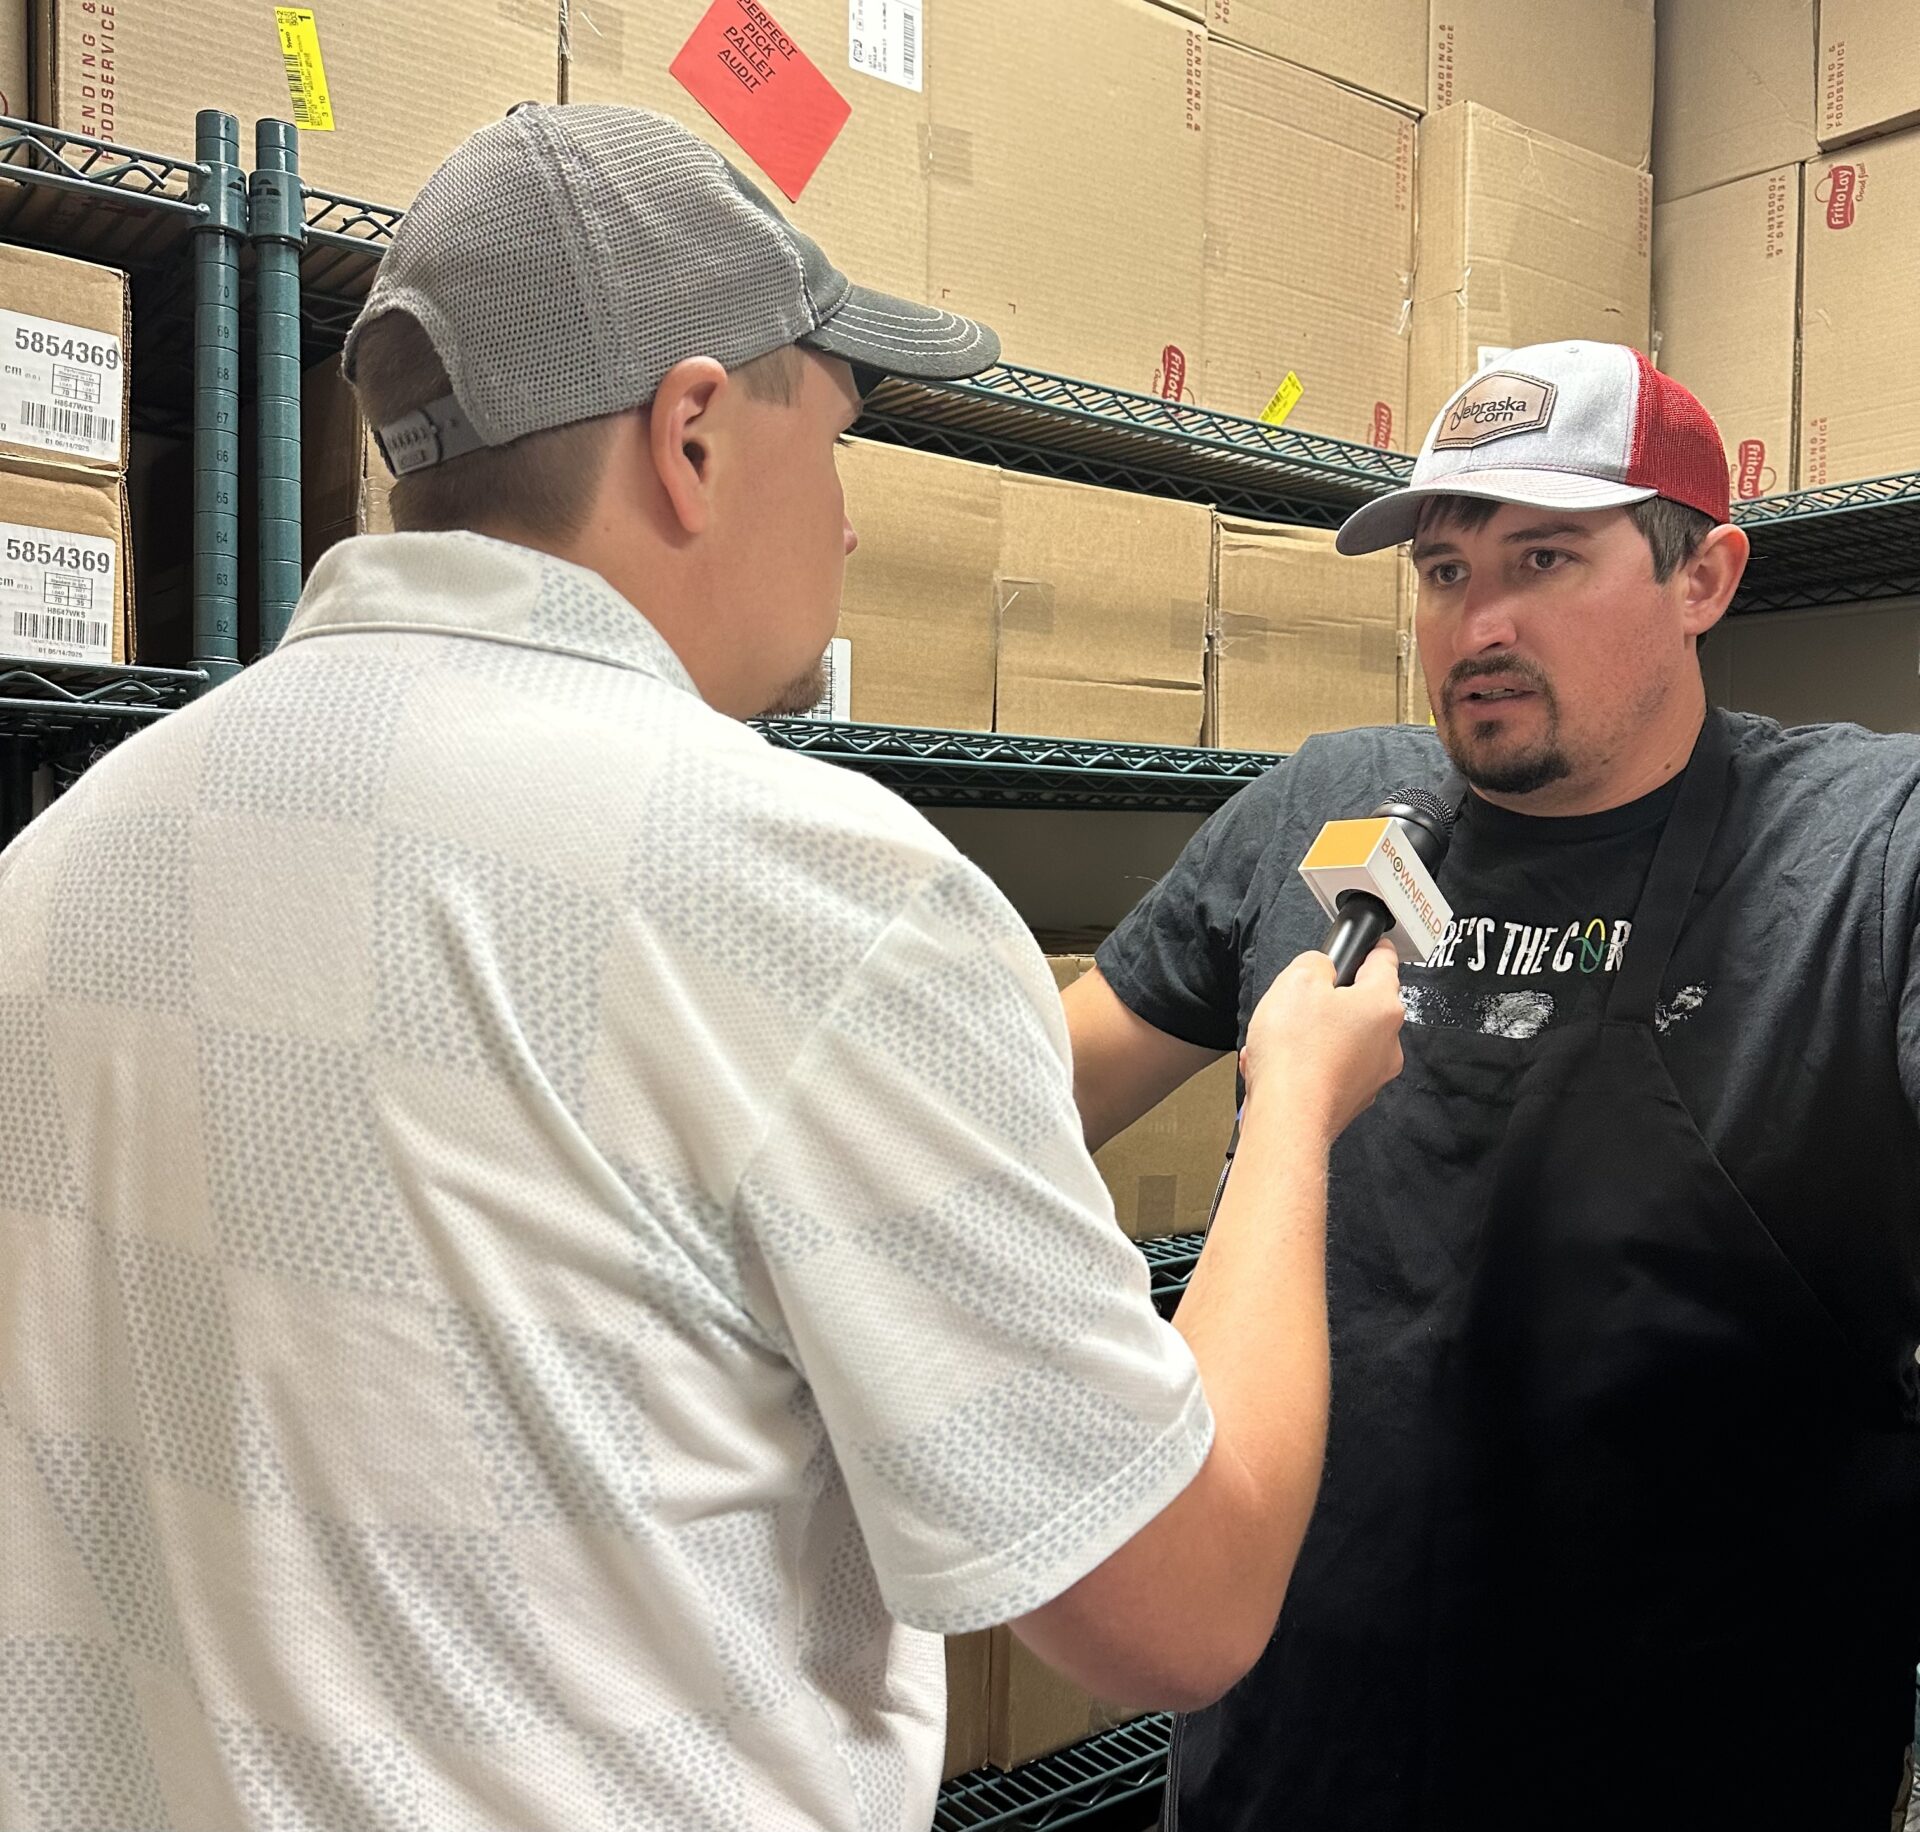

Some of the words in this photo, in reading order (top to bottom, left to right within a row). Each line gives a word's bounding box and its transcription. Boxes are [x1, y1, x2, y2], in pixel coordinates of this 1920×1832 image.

[82, 2, 96, 14] &
[725, 26, 776, 78] PALLET
[743, 22, 776, 58] PICK
[719, 49, 761, 88] AUDIT
[1186, 29, 1194, 131] FOODSERVICE
[1437, 42, 1446, 111] VENDING
[1445, 25, 1455, 106] OODSERVICE
[1825, 63, 1836, 130] VENDING
[1835, 41, 1846, 128] FOODSERVICE
[1775, 174, 1786, 239] VENDING
[1855, 179, 1867, 203] Good
[1766, 177, 1776, 259] FOODSERVICE
[217, 285, 230, 299] 70
[15, 327, 119, 371] 5854369
[217, 325, 230, 339] 69
[4, 364, 23, 377] cm
[217, 366, 230, 381] 68
[216, 411, 229, 425] 67
[1450, 396, 1528, 431] Nebraska
[216, 450, 229, 463] 66
[1809, 437, 1818, 483] NDING
[1819, 416, 1828, 485] ODSERVICE
[216, 491, 229, 505] 65
[216, 531, 228, 544] 64
[6, 538, 110, 574] 5854369
[216, 572, 228, 586] 63
[216, 619, 229, 633] 62
[1381, 837, 1442, 936] BROWNFIELD
[1496, 920, 1558, 976] THE
[1551, 917, 1633, 974] COR
